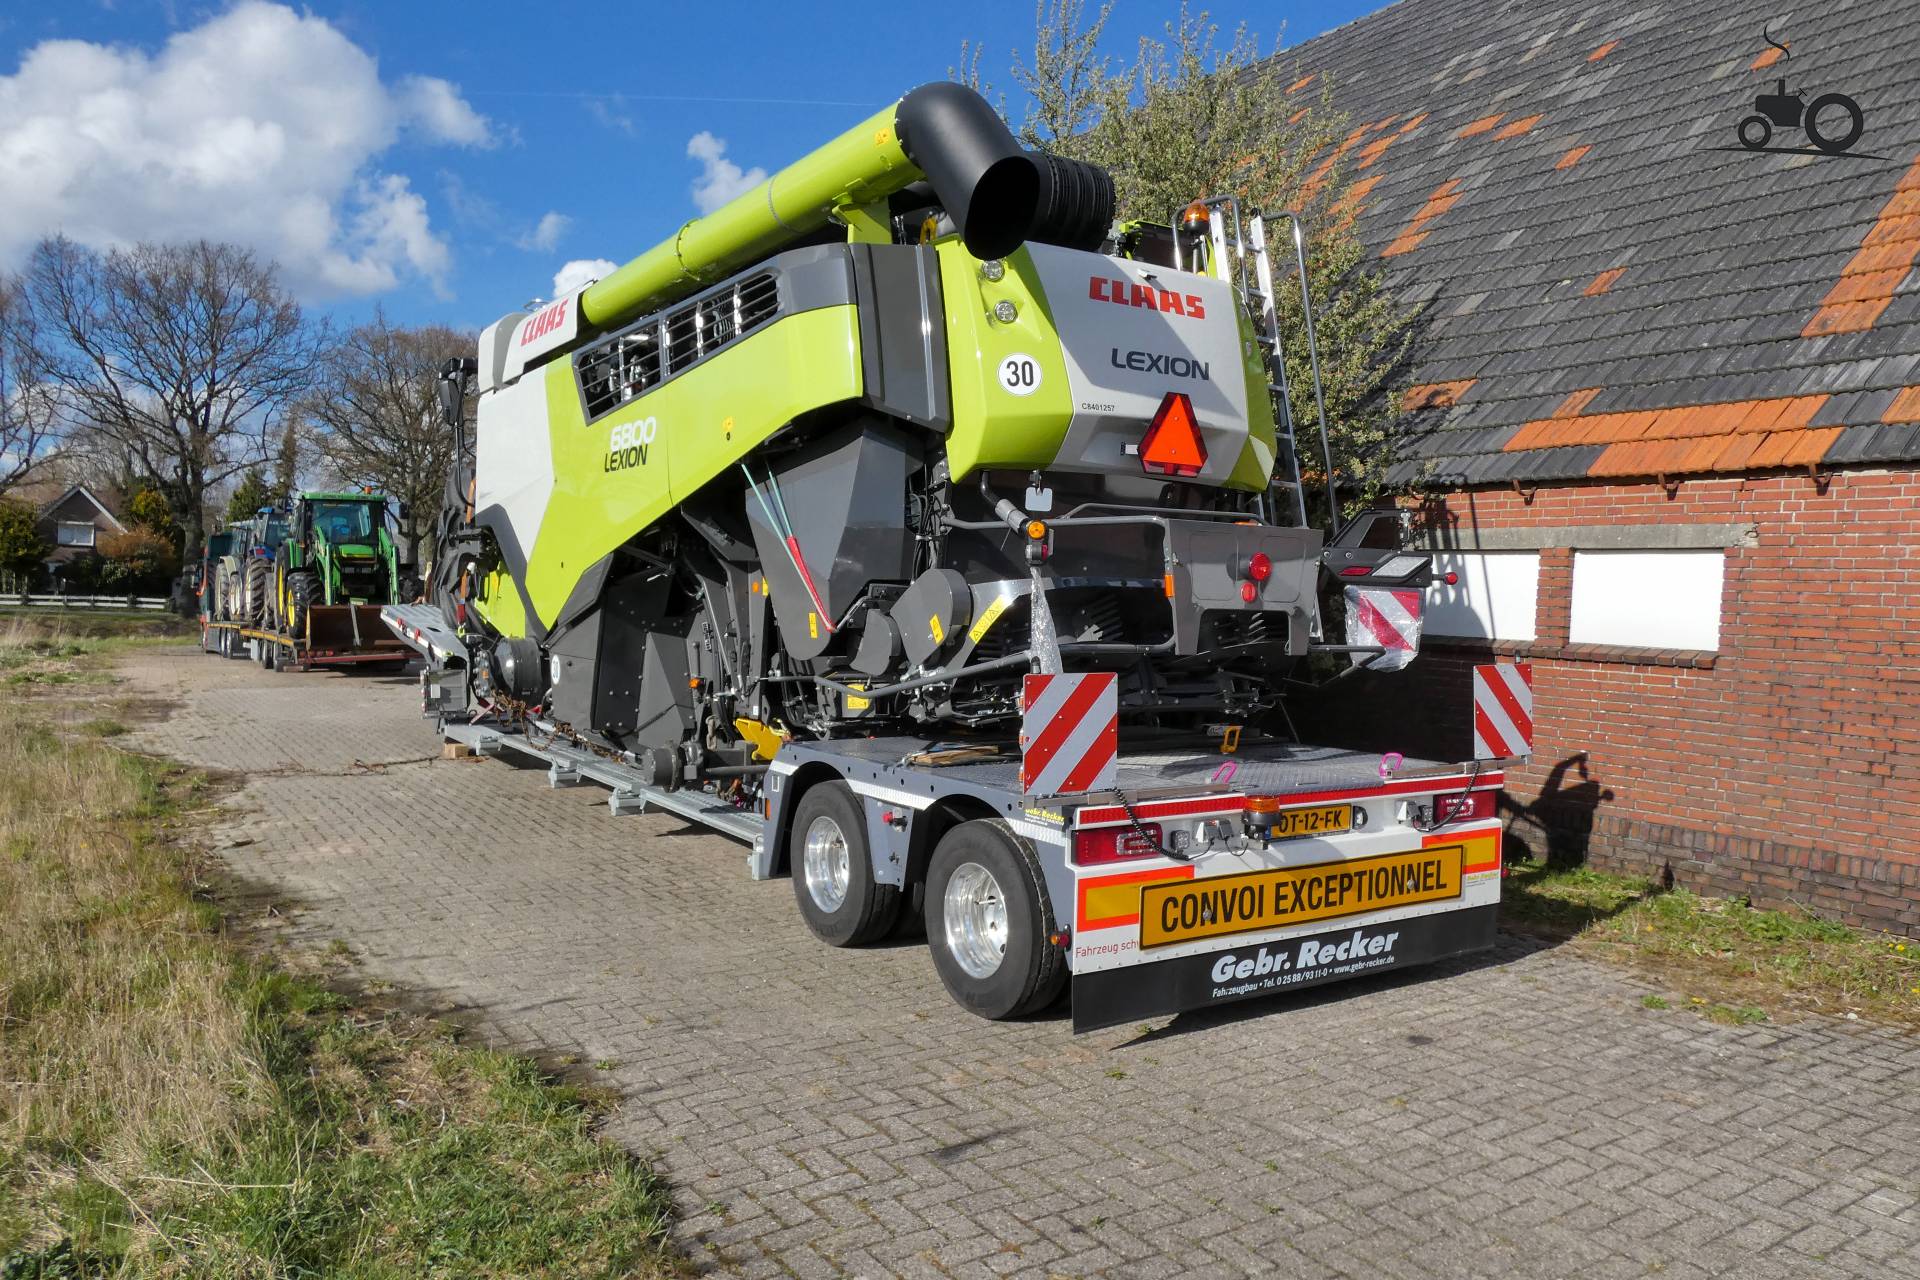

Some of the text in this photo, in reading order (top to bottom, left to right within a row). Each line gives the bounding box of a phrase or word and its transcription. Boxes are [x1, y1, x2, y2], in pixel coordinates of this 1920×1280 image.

[1089, 276, 1206, 320] CLAAS
[520, 297, 569, 347] CLAAS
[1006, 360, 1034, 387] 30
[1111, 348, 1210, 381] LEXION
[611, 416, 657, 452] 6800
[604, 443, 648, 473] LEXION
[1161, 859, 1448, 933] CONVOI EXCEPTIONNEL
[1075, 943, 1119, 959] Fahrzeug
[1211, 930, 1399, 983] Gebr. Recker
[1212, 983, 1258, 998] Fahrzeugbau
[1264, 979, 1276, 988] Tel.
[1333, 954, 1395, 973] www.gebr-recker.de
